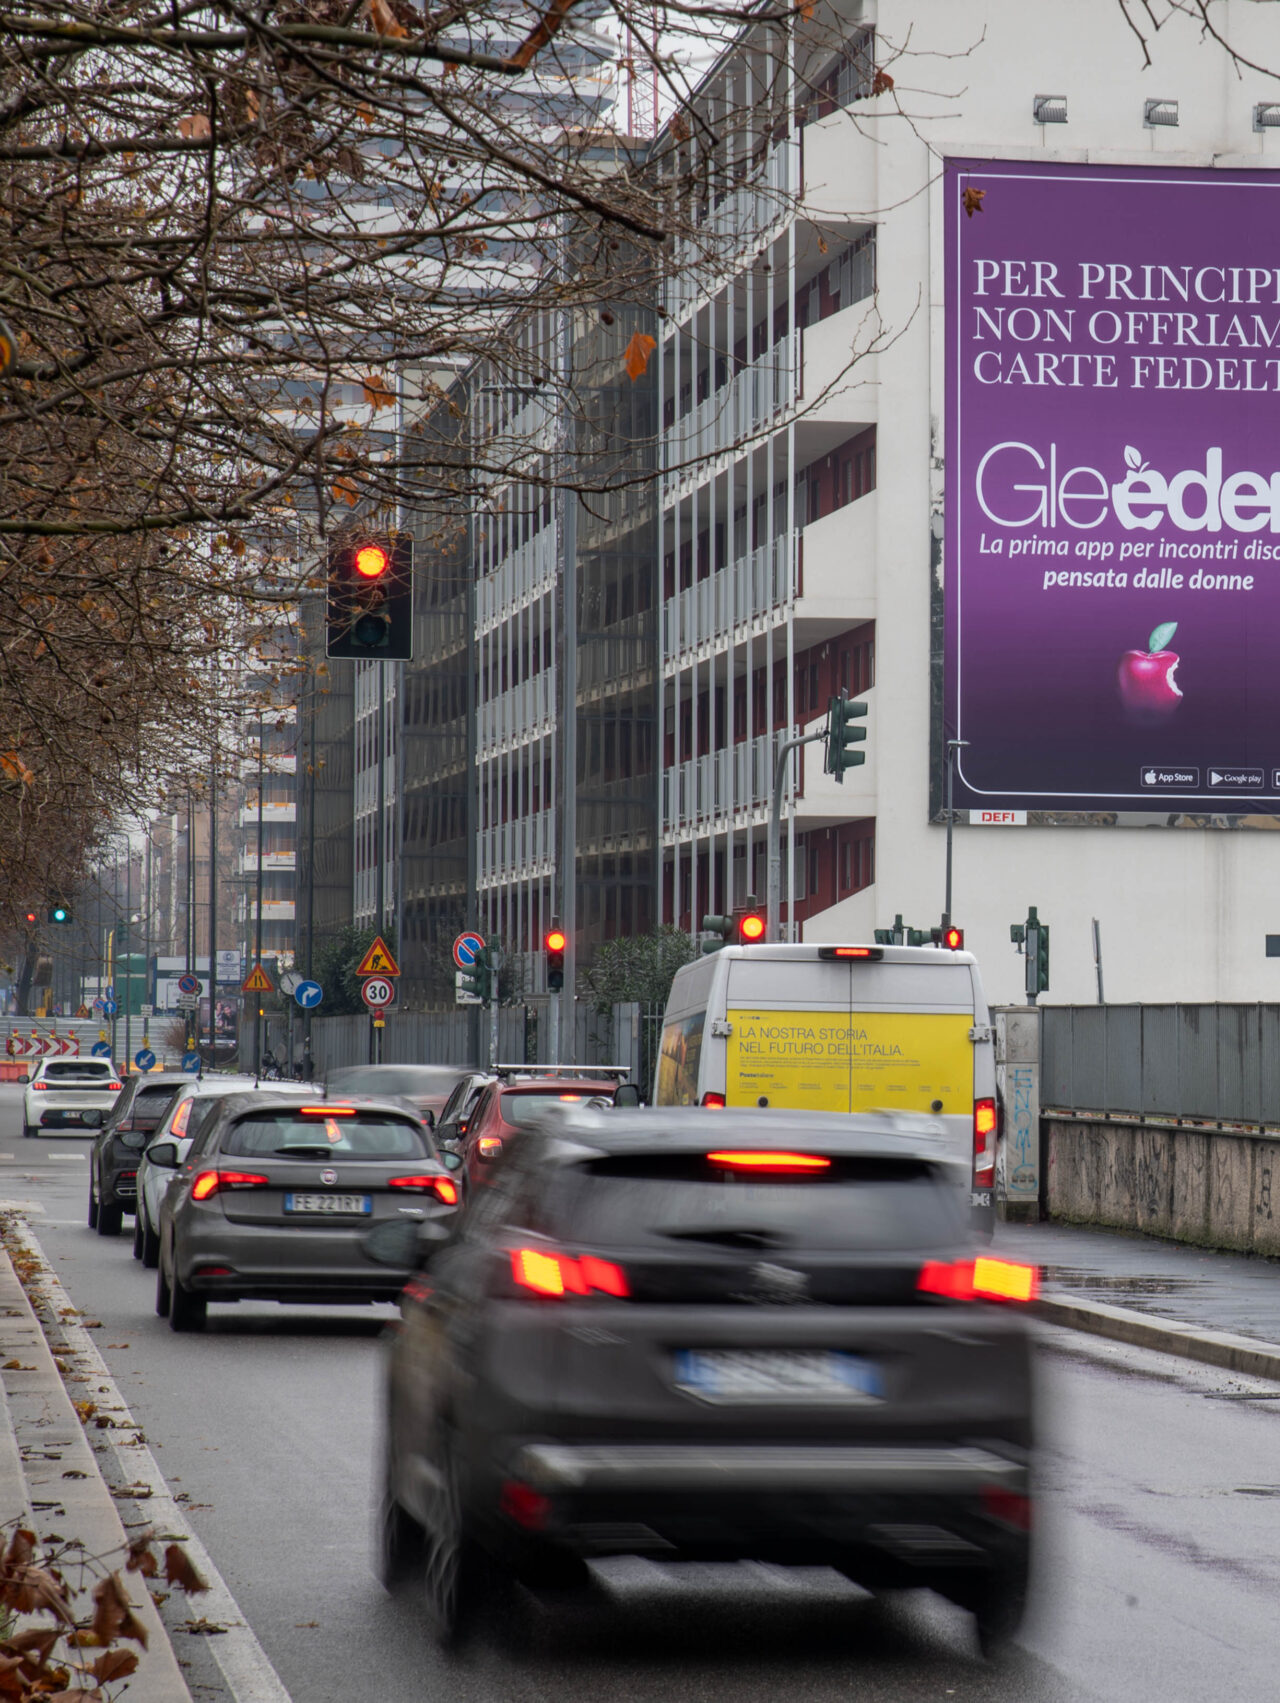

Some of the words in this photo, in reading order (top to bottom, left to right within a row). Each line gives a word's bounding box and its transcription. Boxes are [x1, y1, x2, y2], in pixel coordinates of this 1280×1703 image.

[973, 259, 1066, 298] PER
[972, 306, 1076, 343] NON
[973, 350, 1118, 387] CARTE
[980, 533, 1003, 555] La
[1008, 534, 1070, 558] prima
[1075, 539, 1114, 561] app
[1119, 539, 1155, 562] per
[1159, 537, 1239, 560] incontri
[1043, 567, 1128, 590] pensata
[1133, 567, 1184, 589] dalle
[1189, 569, 1255, 591] donne
[1158, 773, 1174, 783] App
[1174, 773, 1193, 782] Store
[1224, 774, 1248, 784] Google
[1248, 775, 1262, 784] play
[982, 812, 1015, 822] DEFI
[369, 985, 388, 1000] 30
[739, 1027, 757, 1039] LA
[759, 1027, 815, 1039] NOSTRA
[819, 1028, 868, 1041] STORIA
[739, 1041, 766, 1054] NEL
[769, 1042, 824, 1055] FUTURO
[827, 1042, 905, 1057] DELL'ITALIA.
